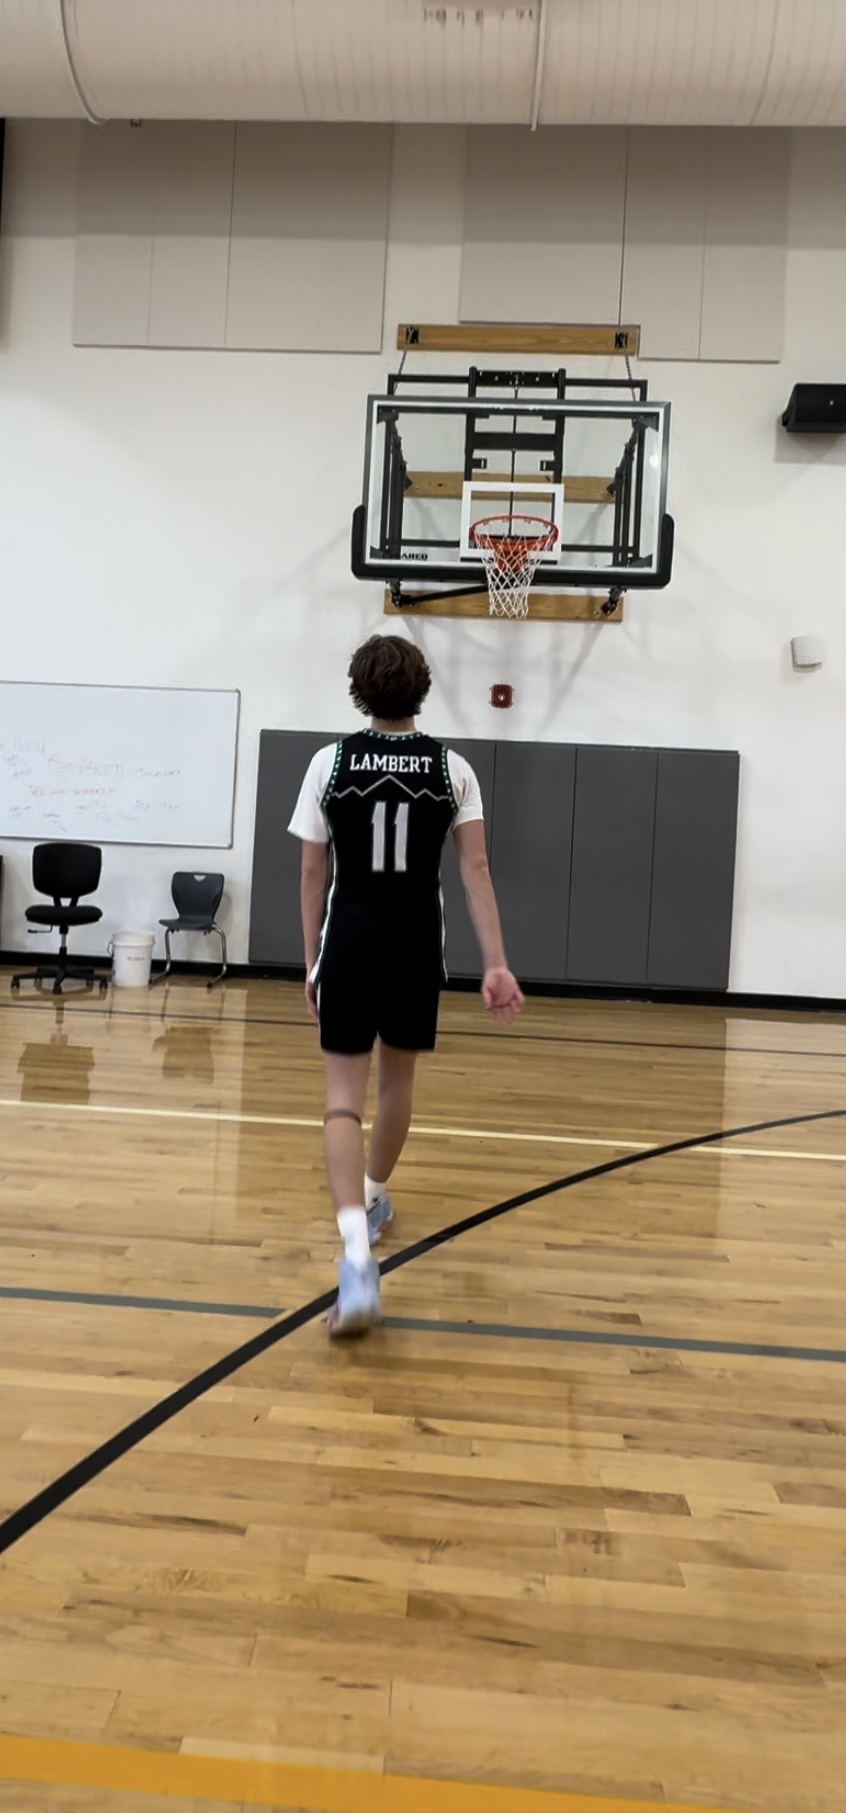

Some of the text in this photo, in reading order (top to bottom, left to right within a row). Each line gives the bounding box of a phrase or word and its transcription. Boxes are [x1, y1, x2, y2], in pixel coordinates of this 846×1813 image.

[395, 553, 428, 561] ARED
[349, 753, 433, 773] LAMBERT
[371, 801, 409, 872] 11
